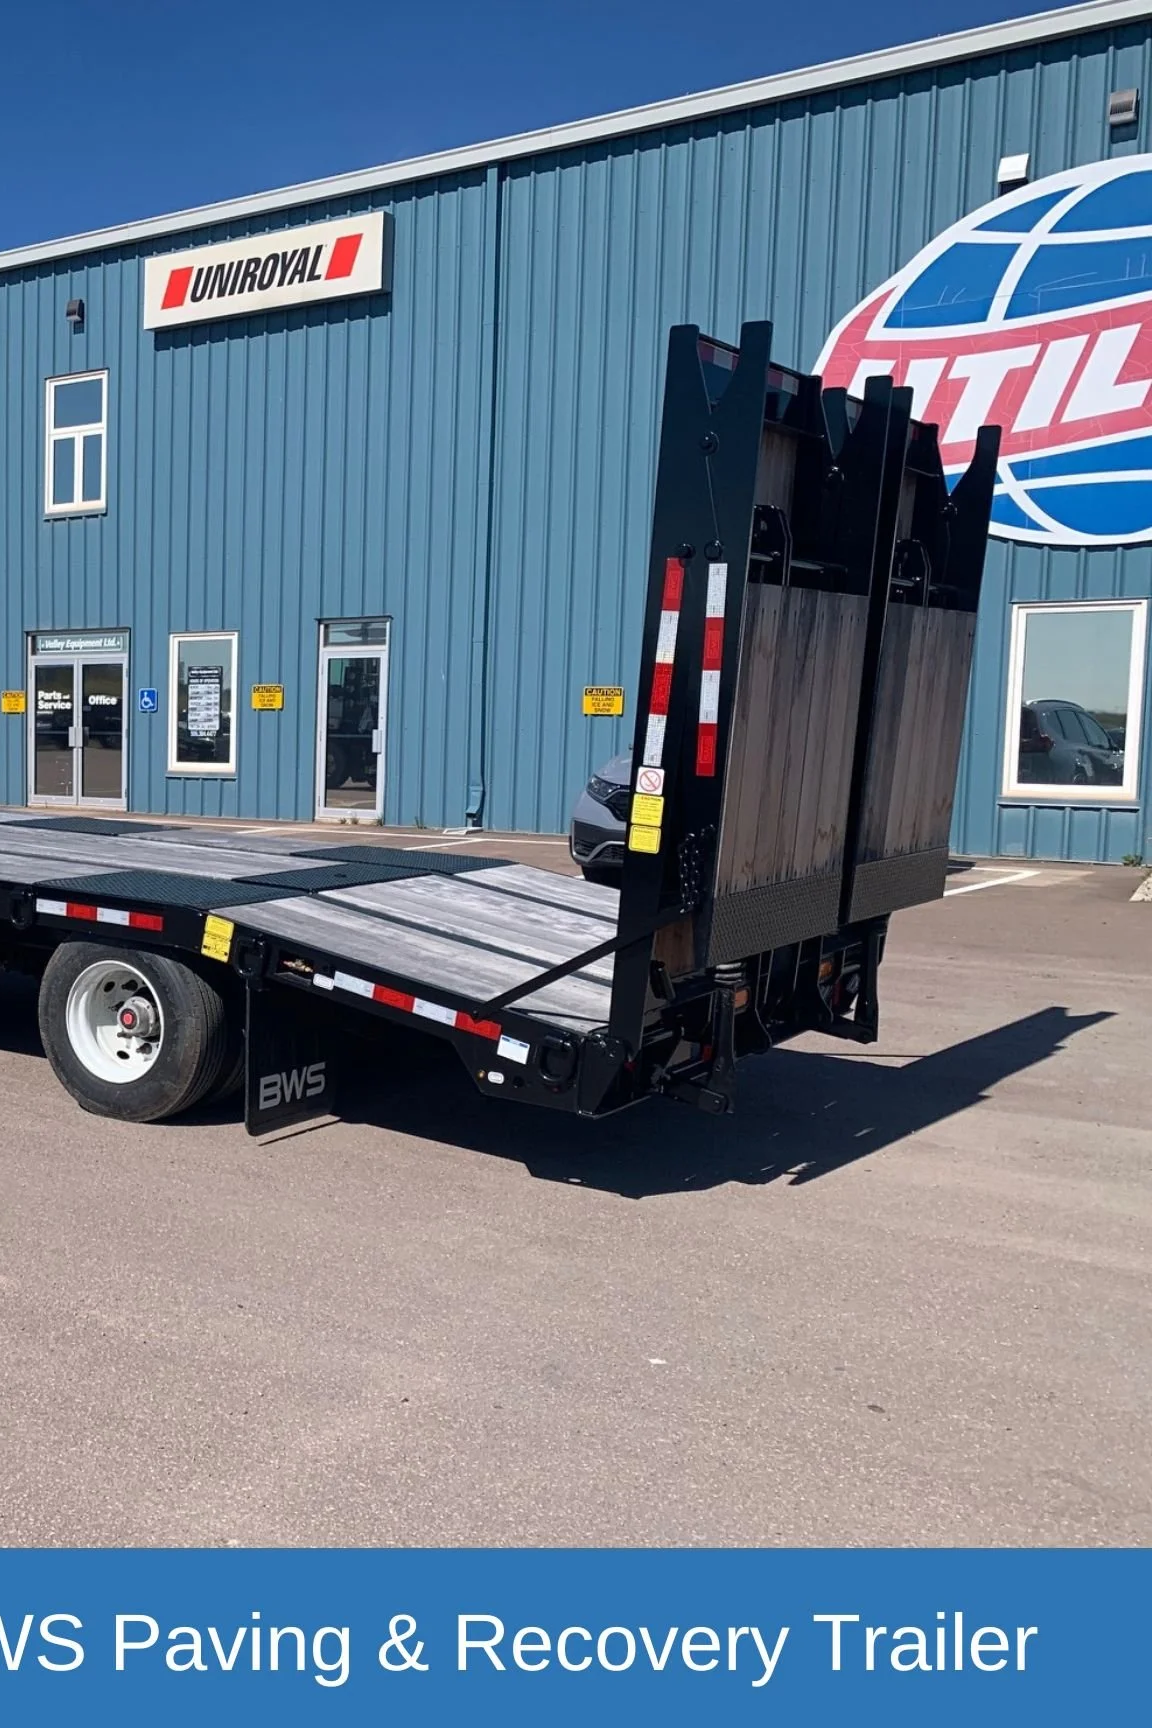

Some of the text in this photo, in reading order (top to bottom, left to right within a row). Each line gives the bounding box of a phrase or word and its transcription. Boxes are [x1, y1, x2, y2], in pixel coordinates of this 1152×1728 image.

[190, 244, 324, 303] UNIROYAL
[45, 636, 117, 651] Valley Equipment Ltd.
[37, 690, 62, 700] Parts
[586, 688, 621, 696] CAUTION
[37, 700, 72, 710] Service
[88, 695, 117, 705] Office
[259, 1062, 326, 1111] BWS
